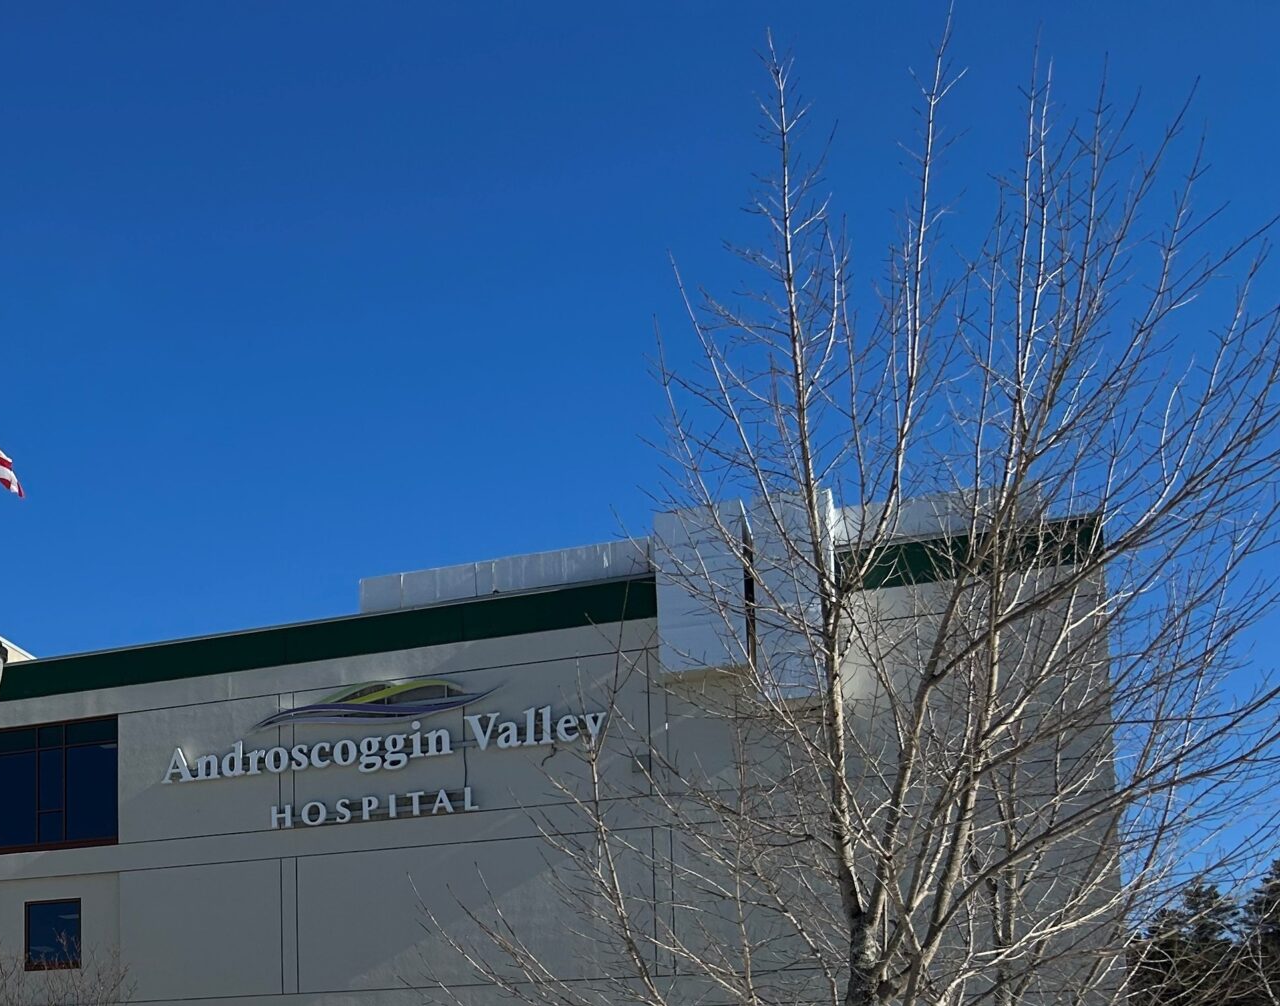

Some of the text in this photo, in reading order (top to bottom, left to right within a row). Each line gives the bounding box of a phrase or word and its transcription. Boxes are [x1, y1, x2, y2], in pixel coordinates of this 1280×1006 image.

[161, 705, 607, 784] Androscoggin Valley
[271, 786, 480, 829] HOSPITAL
